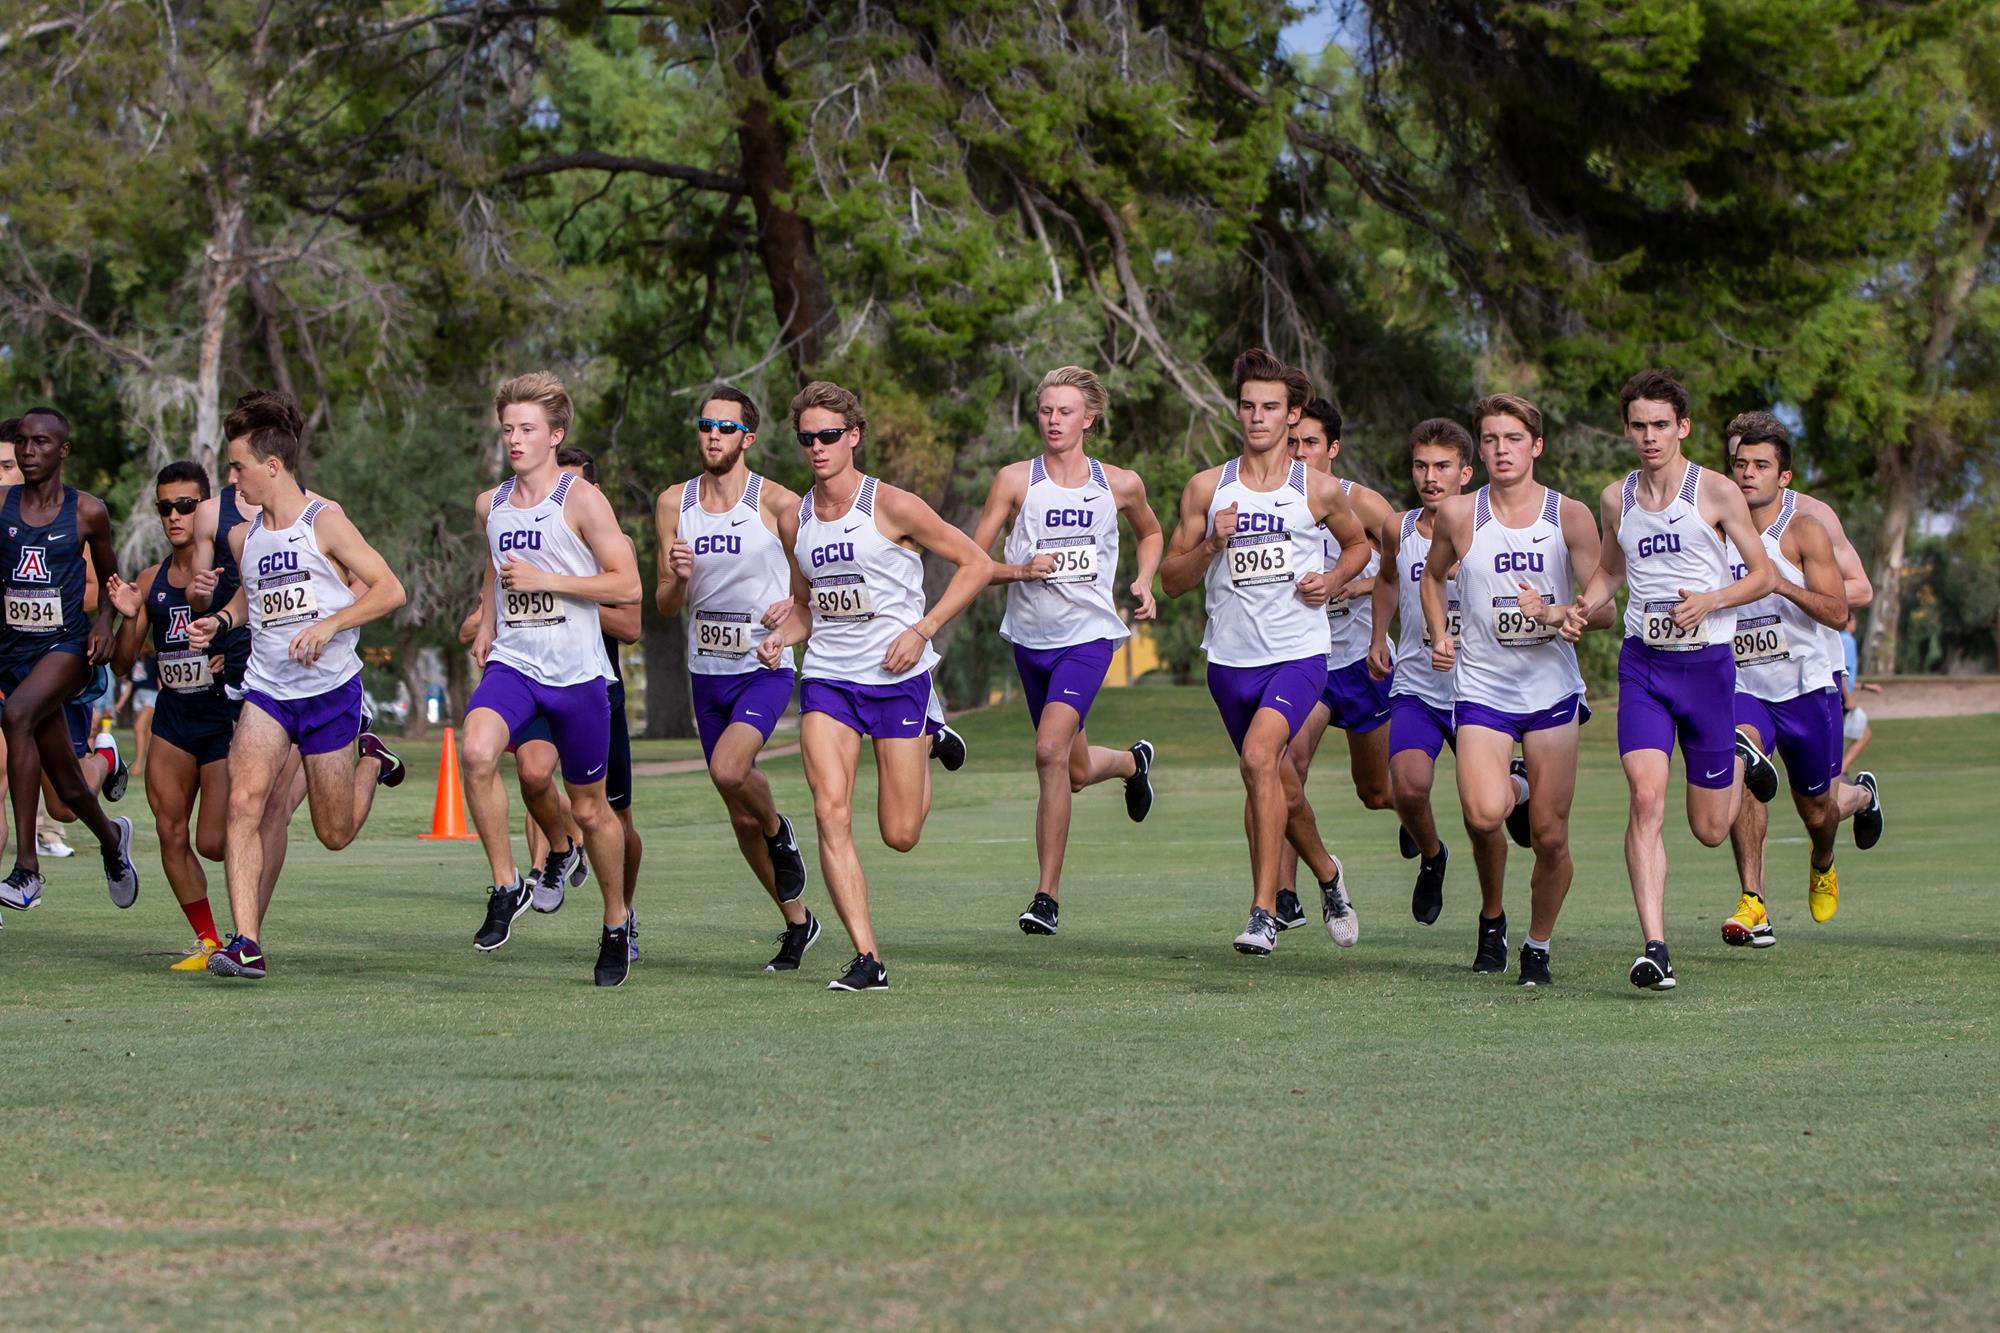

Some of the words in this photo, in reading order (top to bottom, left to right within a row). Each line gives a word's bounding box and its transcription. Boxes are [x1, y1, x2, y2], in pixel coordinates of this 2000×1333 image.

[1046, 509, 1094, 528] GCU
[1236, 513, 1285, 533] GCU
[499, 530, 542, 552] GCU
[695, 534, 742, 556] GCU
[1638, 533, 1681, 558] GCU
[13, 546, 51, 583] A
[258, 551, 298, 576] GCU
[811, 542, 855, 568] GCU
[1045, 550, 1090, 571] 956
[1234, 547, 1285, 574] 8963
[1494, 551, 1544, 574] GCU
[9, 601, 54, 621] 8934
[263, 587, 307, 614] 8962
[508, 592, 554, 615] 8950
[817, 588, 861, 611] 8961
[165, 605, 192, 643] A
[701, 624, 741, 647] 8951
[1734, 630, 1778, 656] 8960
[163, 661, 202, 684] 8937
